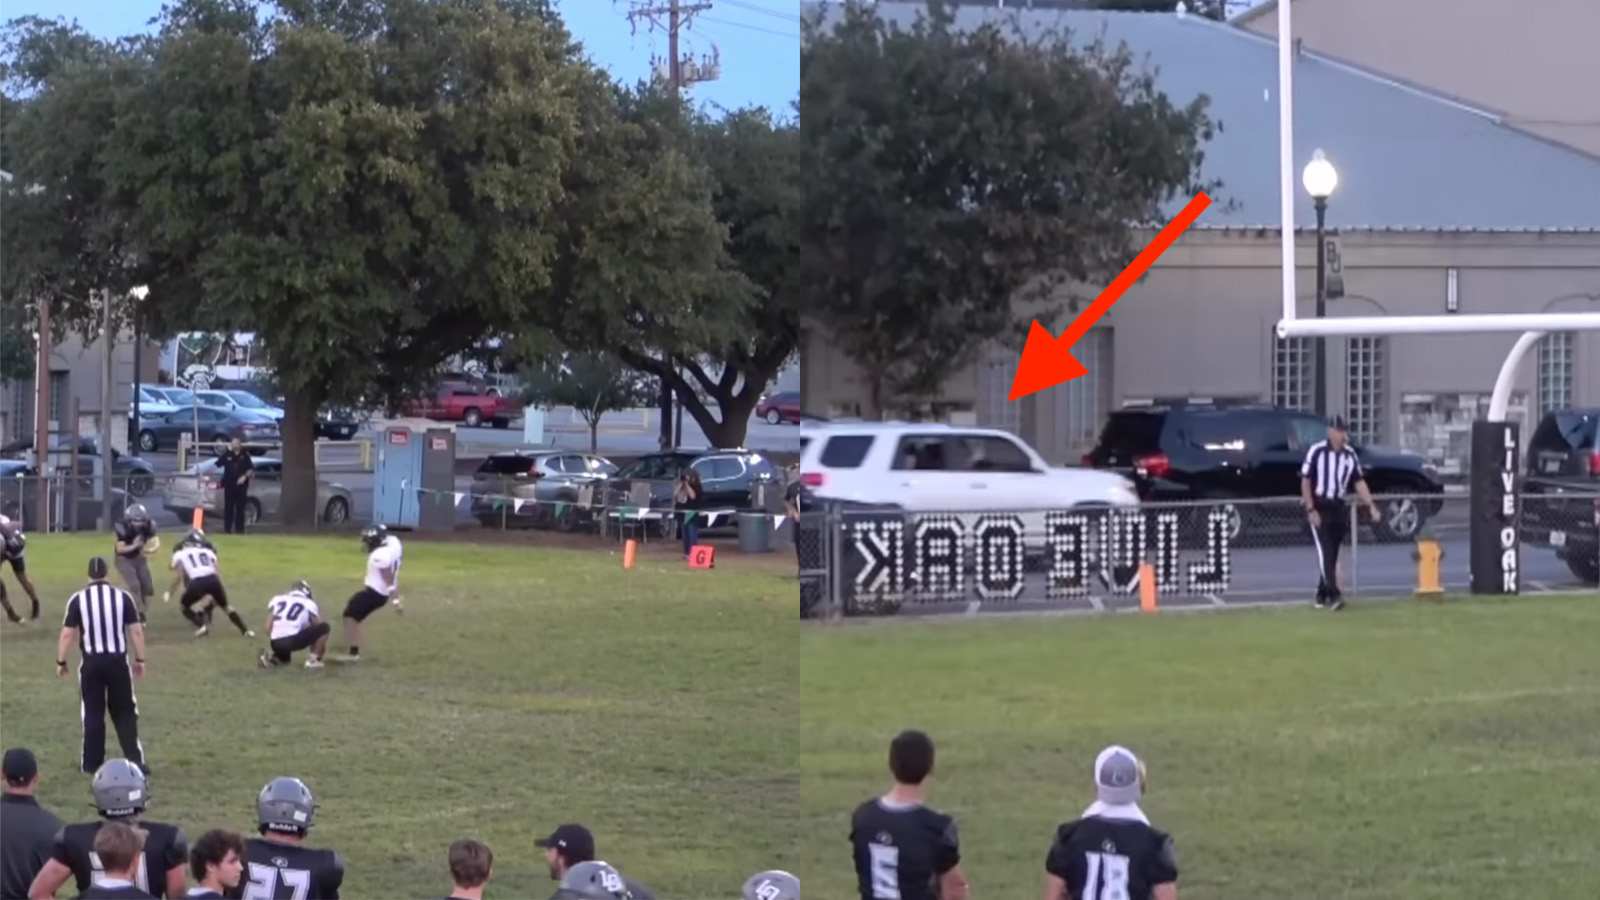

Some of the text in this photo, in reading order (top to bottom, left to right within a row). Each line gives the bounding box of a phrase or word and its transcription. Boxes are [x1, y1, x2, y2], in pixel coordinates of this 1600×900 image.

[1501, 427, 1516, 592] LIVE OAK
[188, 552, 210, 568] 10
[695, 549, 706, 565] G
[273, 601, 305, 622] 20
[241, 861, 311, 900] 27
[868, 842, 901, 900] 5
